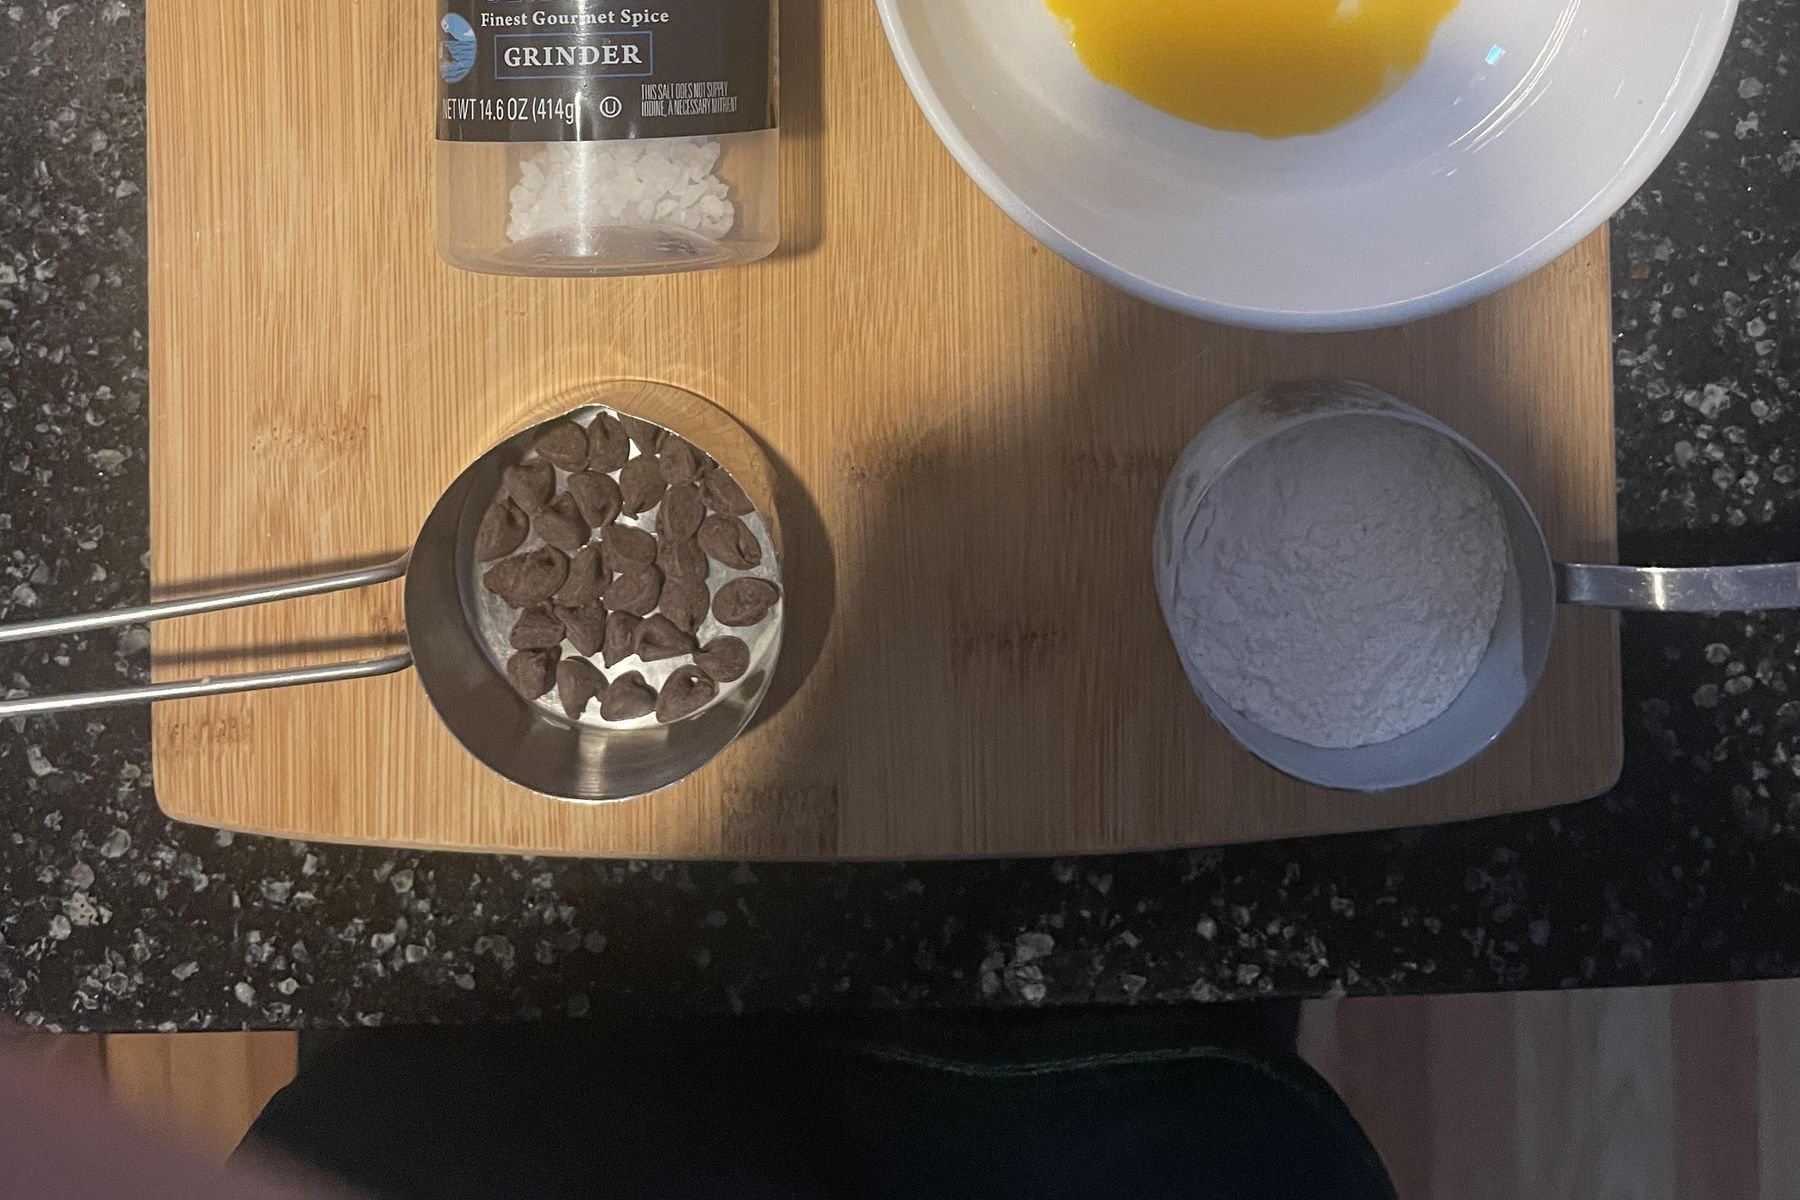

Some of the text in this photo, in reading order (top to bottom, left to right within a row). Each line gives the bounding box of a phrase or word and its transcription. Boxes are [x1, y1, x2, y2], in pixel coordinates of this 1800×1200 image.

[481, 8, 670, 28] Finest Gourmet Spice
[503, 44, 643, 67] GRINDER
[657, 83, 674, 100] SALT
[442, 96, 581, 125] NET WT 14.6 OZ (414g
